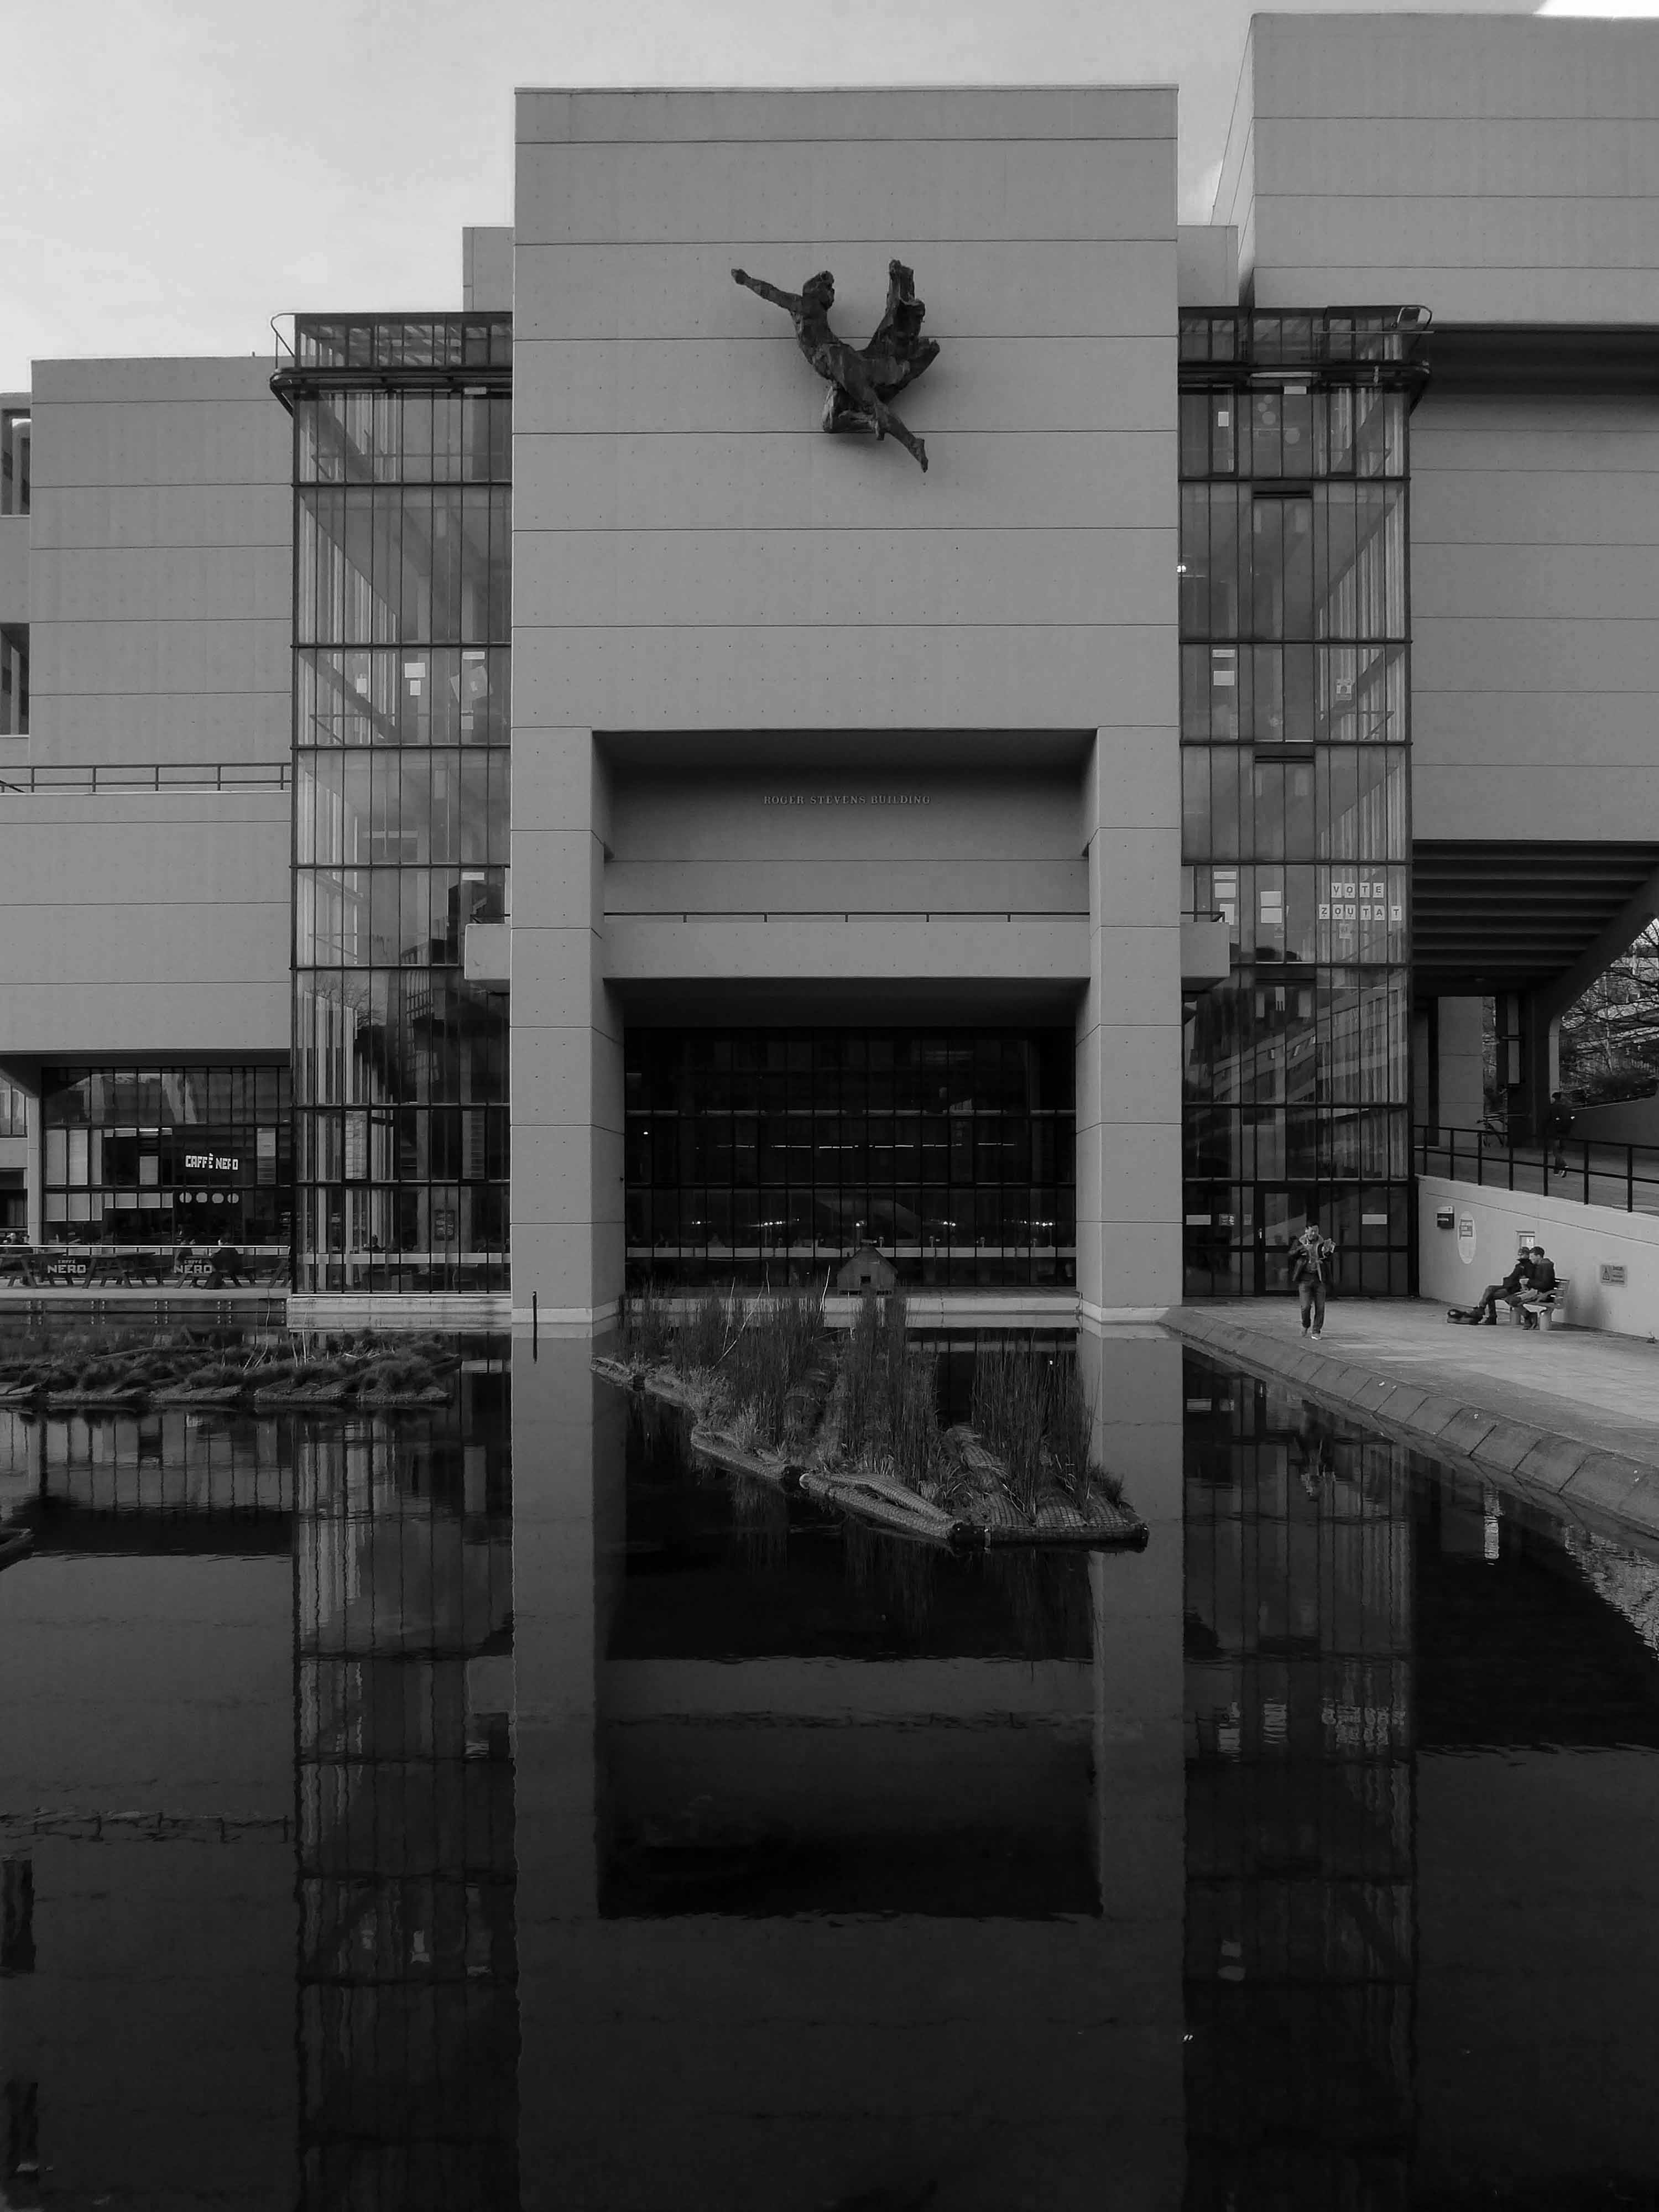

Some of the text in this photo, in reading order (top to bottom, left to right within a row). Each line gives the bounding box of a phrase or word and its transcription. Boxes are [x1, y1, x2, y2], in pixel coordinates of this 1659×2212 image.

[763, 795, 931, 805] ROGER STEVENS BUILDING
[1333, 885, 1381, 894] VOTE
[1321, 907, 1400, 916] ZOUTAT
[47, 1265, 86, 1274] NERO
[173, 1265, 212, 1274] NERO
